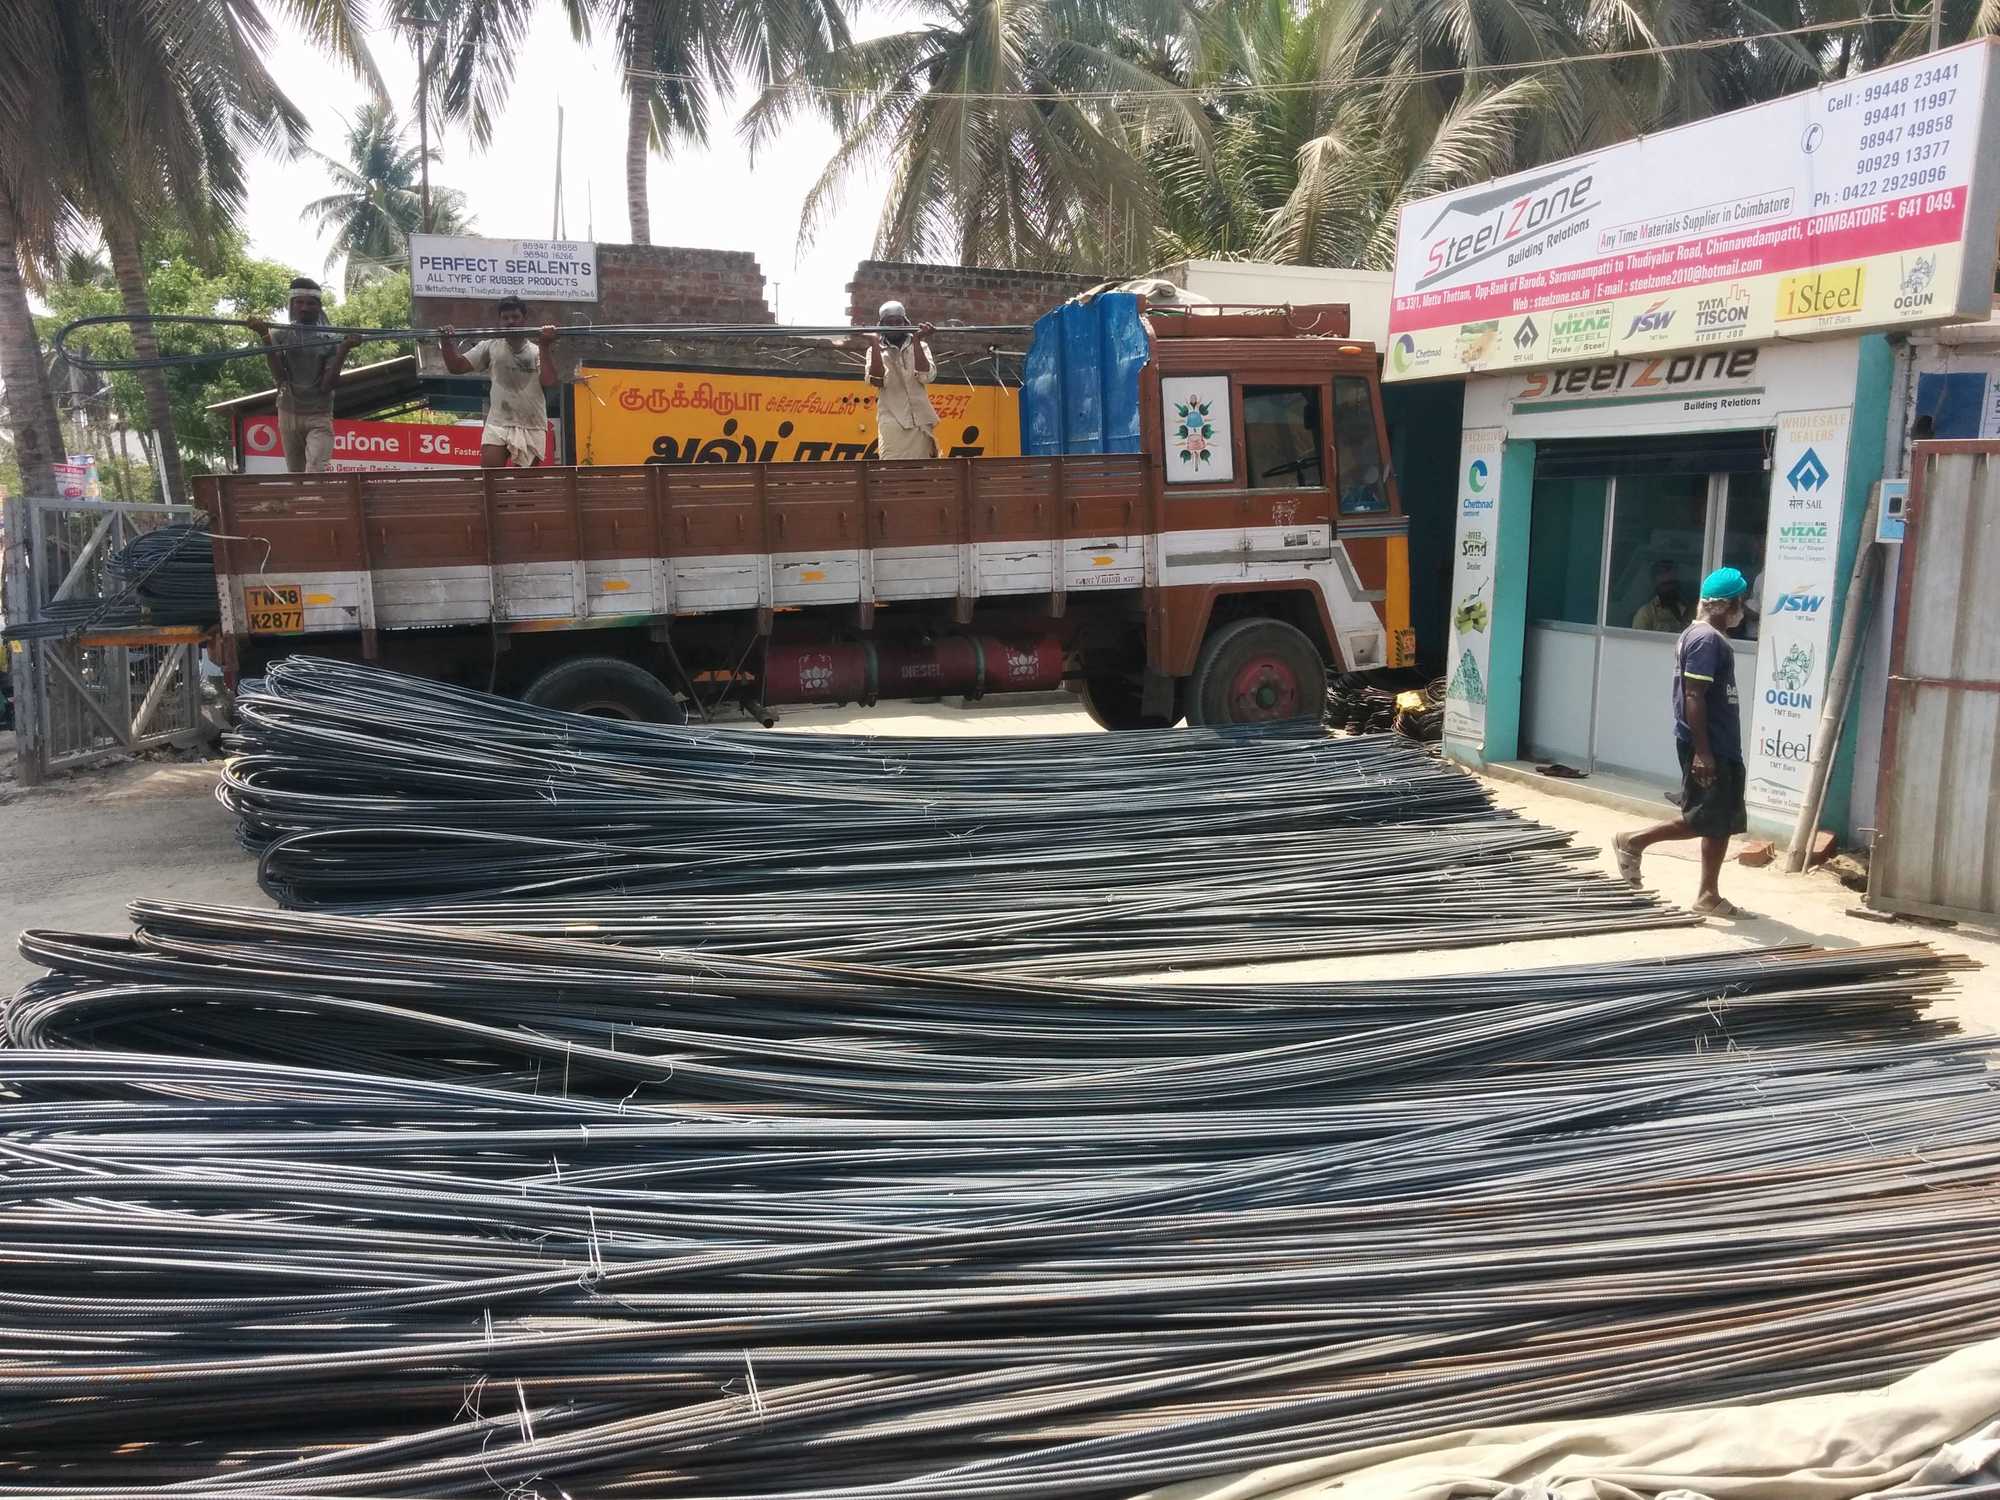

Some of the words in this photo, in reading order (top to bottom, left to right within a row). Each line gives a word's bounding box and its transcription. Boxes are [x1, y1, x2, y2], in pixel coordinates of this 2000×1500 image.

[1828, 93, 1852, 113] Cell
[1864, 77, 1909, 102] 99448
[1914, 64, 1959, 89] 23441
[1863, 102, 1906, 126] 99441
[1913, 88, 1957, 113] 11997
[1860, 127, 1903, 150] 98947
[1907, 115, 1953, 139] 49858
[1857, 151, 1900, 175] 90929
[1906, 140, 1950, 164] 13377
[1813, 192, 1830, 207] Ph
[1843, 180, 1876, 201] 0422
[1881, 165, 1947, 193] 2929096
[1600, 232, 1616, 248] Any
[1619, 229, 1638, 244] Time
[1640, 217, 1681, 240] Materials
[1682, 210, 1720, 232] Supplier
[1723, 208, 1732, 220] in
[1734, 197, 1790, 220] Coimbatore
[1507, 240, 1543, 268] Building
[1547, 217, 1590, 249] Relations
[1509, 277, 1518, 292] of
[1615, 259, 1624, 272] to
[1627, 250, 1675, 271] Thudiyalur
[1677, 242, 1703, 261] Road,
[1706, 222, 1803, 256] Chinnavedampatti,
[1807, 204, 1888, 236] COIMBATORE
[1898, 198, 1921, 219] 641
[1926, 192, 1956, 214] 049.
[420, 256, 498, 272] PERFECT
[505, 260, 591, 275] SEALENTS
[426, 273, 444, 282] ALL
[447, 273, 473, 284] TYPE
[475, 275, 487, 284] OF
[490, 275, 525, 285] RUBBER
[528, 277, 578, 287] PRODUCTS
[1513, 297, 1529, 311] Web
[1629, 258, 1762, 292] steelzone2010@hotmail.com
[1697, 298, 1724, 311] TATA
[1894, 293, 1933, 309] OGUN
[1553, 315, 1610, 335] VIZAG
[1622, 310, 1677, 340] JSW
[1696, 306, 1748, 326] TISCON
[1583, 342, 1606, 351] Steel
[1683, 400, 1718, 411] Building
[1720, 397, 1761, 409] Relations
[334, 431, 400, 452] afone
[420, 434, 450, 455] 3G
[1768, 592, 1825, 615] JSW
[1766, 689, 1812, 709] OGUN
[1774, 708, 1787, 717] TMT
